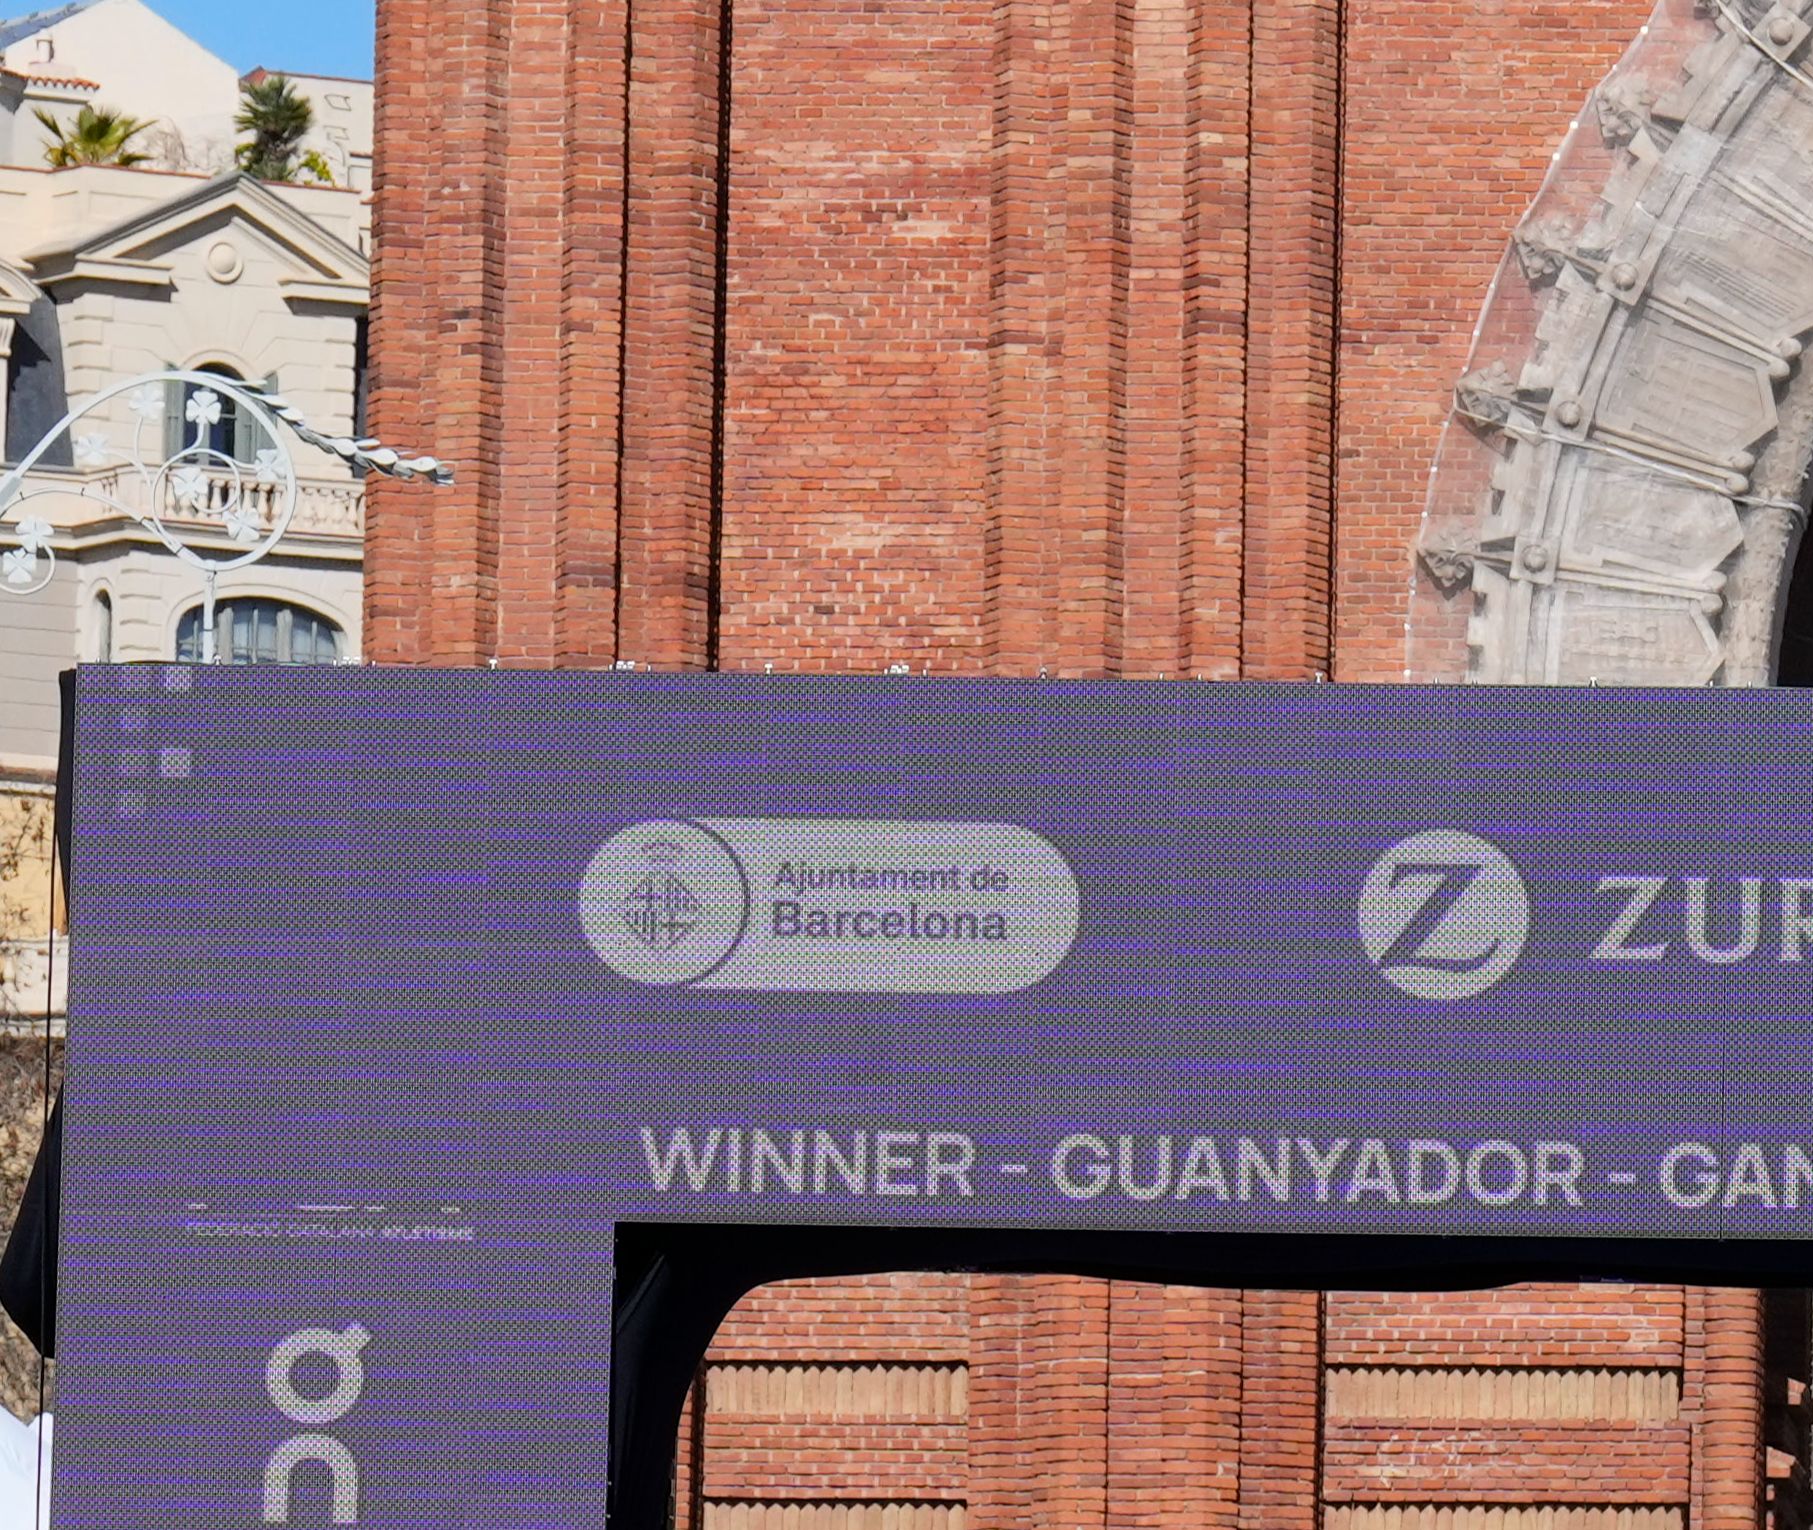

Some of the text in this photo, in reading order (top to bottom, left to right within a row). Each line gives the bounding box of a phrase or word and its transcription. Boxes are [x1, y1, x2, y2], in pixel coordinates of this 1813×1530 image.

[774, 863, 1010, 896] Ajuntament de
[772, 900, 1007, 942] Barcelona
[640, 1126, 976, 1198] WINNER
[1052, 1132, 1584, 1208] GUANYADOR
